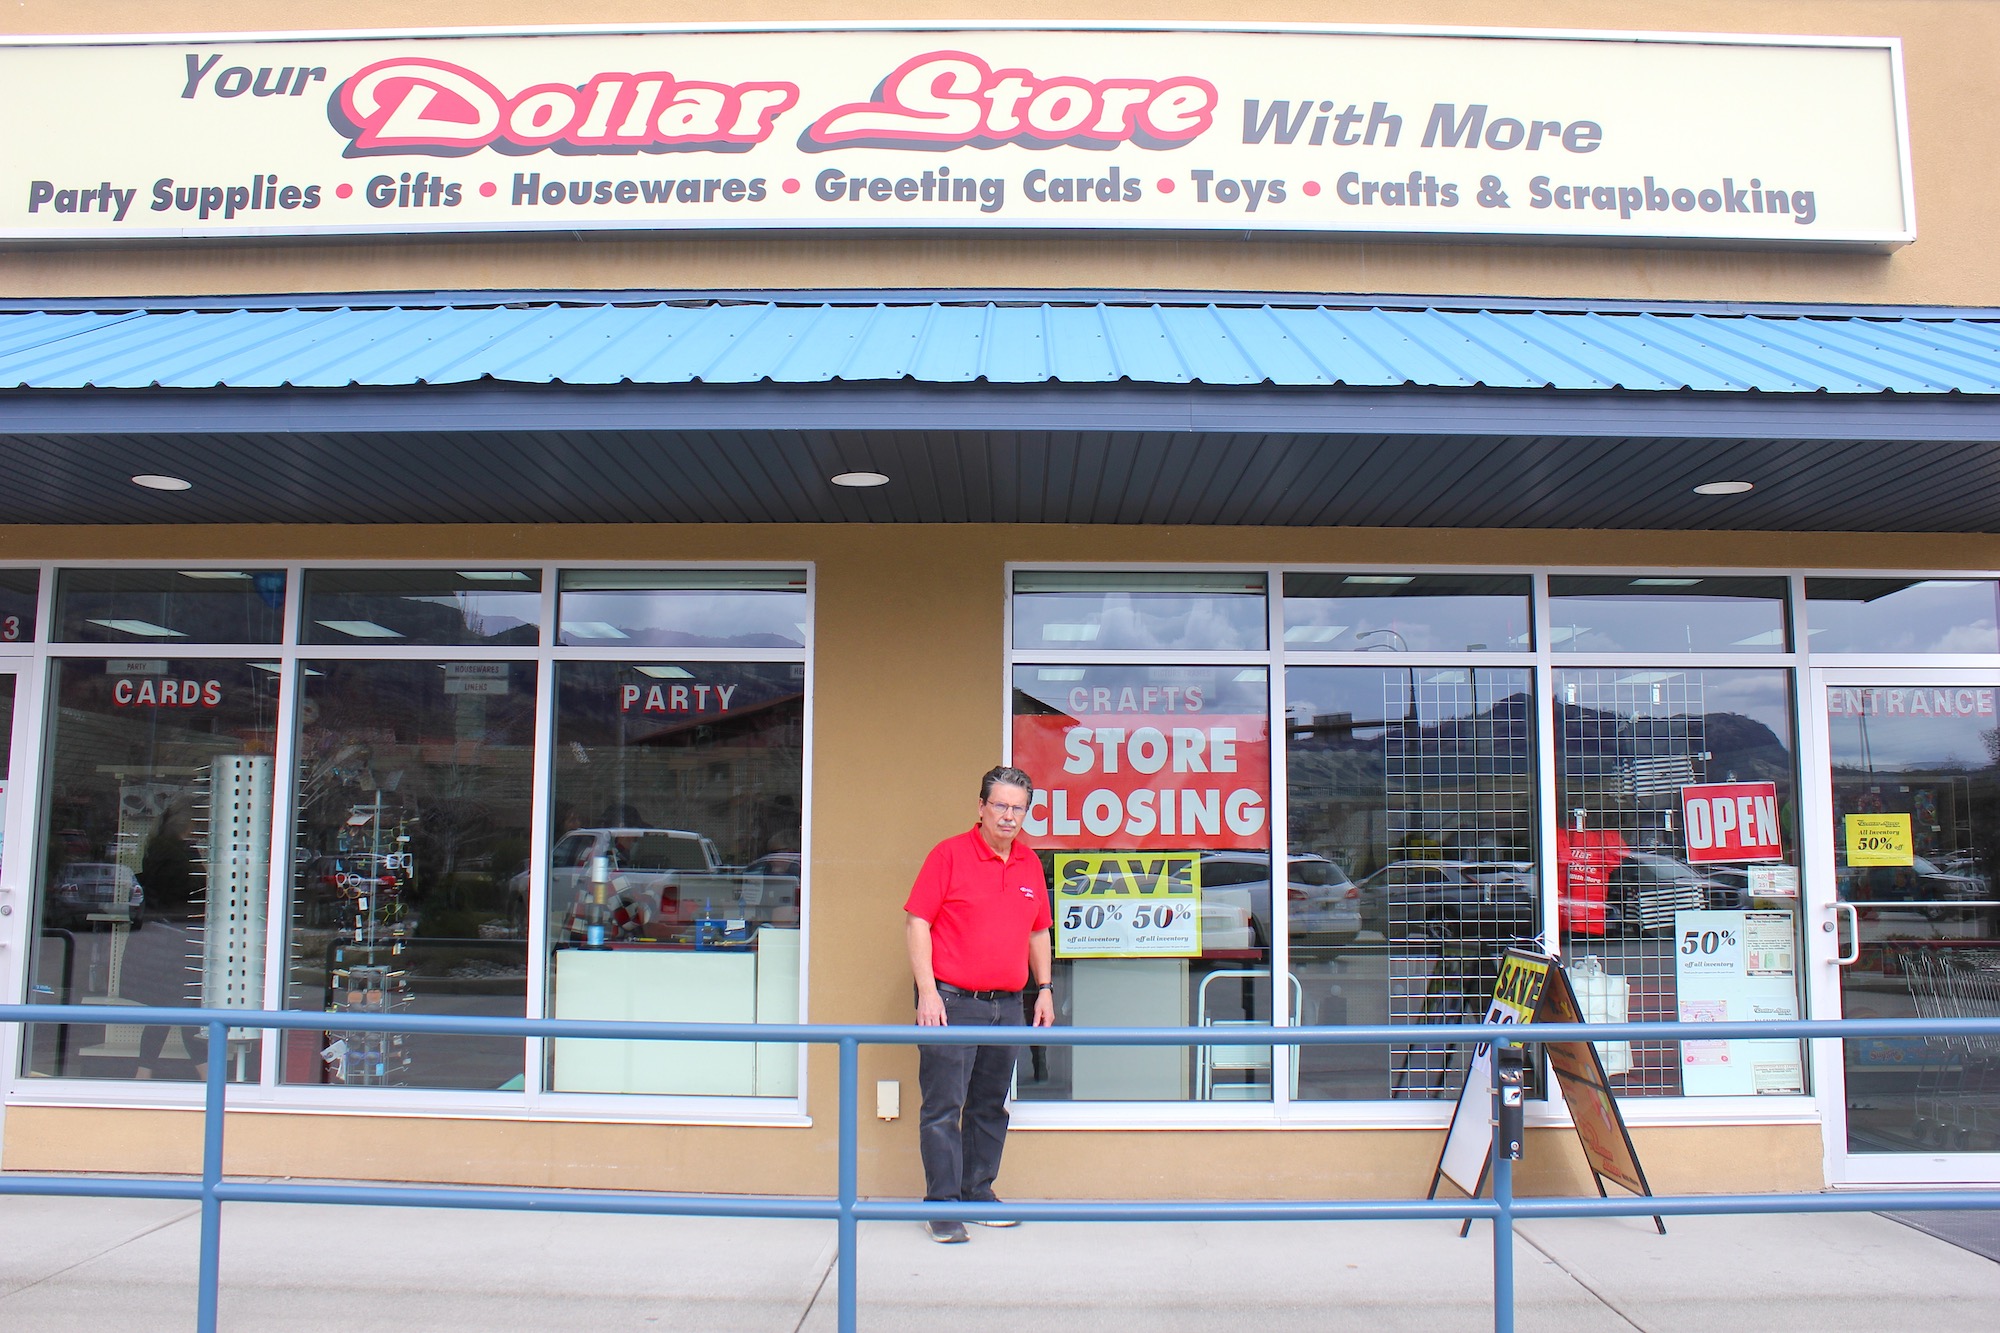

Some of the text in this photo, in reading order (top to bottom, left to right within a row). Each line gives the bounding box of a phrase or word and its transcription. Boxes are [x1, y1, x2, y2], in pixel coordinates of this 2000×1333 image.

[181, 50, 1603, 158] Your Dollar Store With More
[27, 166, 1817, 225] Party Supplies Gifts Housewares Greeting Cards Toys Crafts & Scrapbooking
[4, 616, 20, 640] 3
[126, 662, 148, 671] PARTY
[454, 665, 500, 673] HOUSEWARES
[113, 679, 222, 708] CARDS
[621, 684, 737, 713] PARTY
[1068, 686, 1204, 713] CRAFTS
[1828, 688, 1993, 717] ENTRANCE
[1062, 726, 1238, 775] STORE
[1022, 787, 1266, 837] CLOSING
[1686, 795, 1779, 850] OPEN
[1857, 837, 1893, 850] 50%
[1061, 859, 1193, 895] SAVE
[1063, 904, 1123, 930] 50%
[1132, 903, 1192, 930] 50%
[1067, 936, 1077, 944] off
[1087, 935, 1120, 944] inventory
[1135, 935, 1146, 943] off
[1156, 934, 1189, 943] inventory
[1681, 930, 1736, 955] 50%
[1684, 961, 1695, 969] off
[1496, 963, 1545, 1010] SAVE
